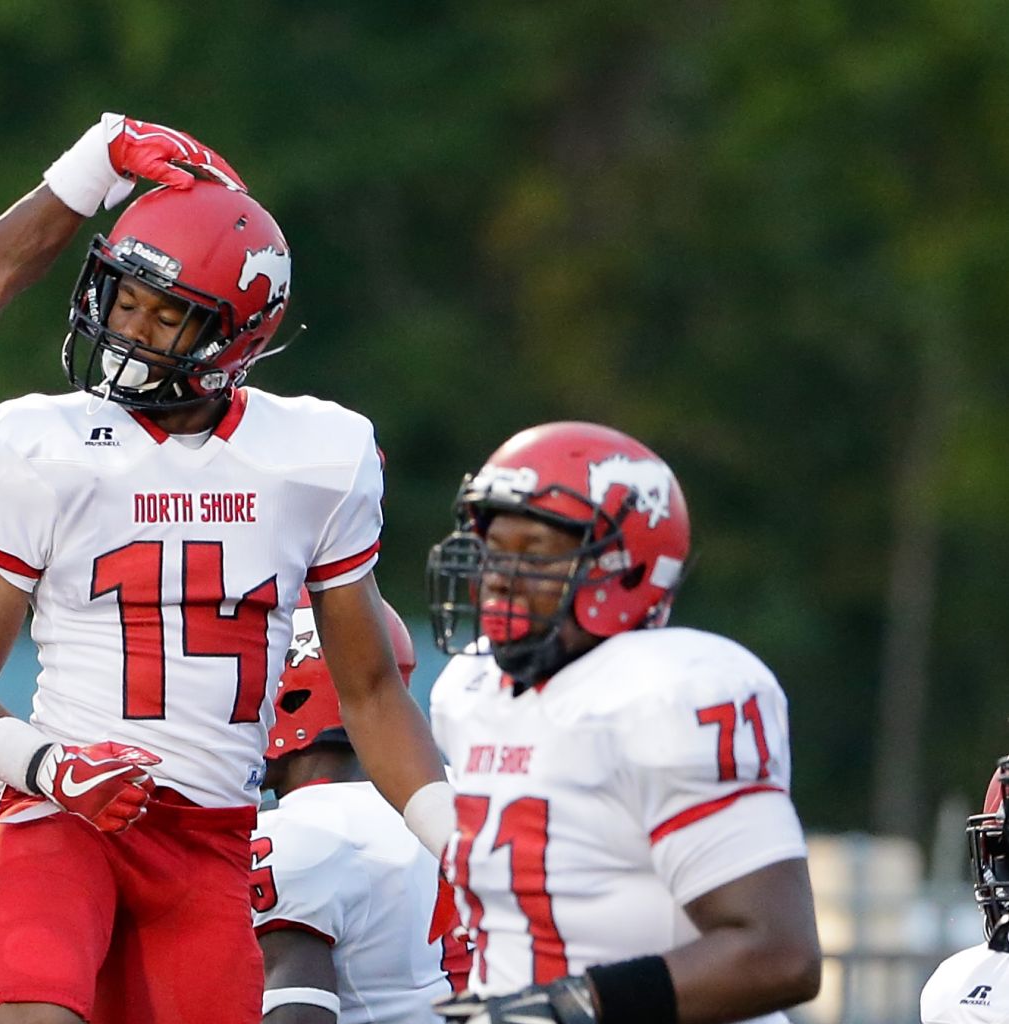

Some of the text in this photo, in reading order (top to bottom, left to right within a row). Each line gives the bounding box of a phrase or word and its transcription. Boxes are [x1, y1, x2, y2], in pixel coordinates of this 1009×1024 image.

[133, 492, 257, 524] NORTH SHORE
[89, 539, 279, 725] 14
[695, 693, 770, 782] 71
[959, 999, 992, 1007] RUSSELL
